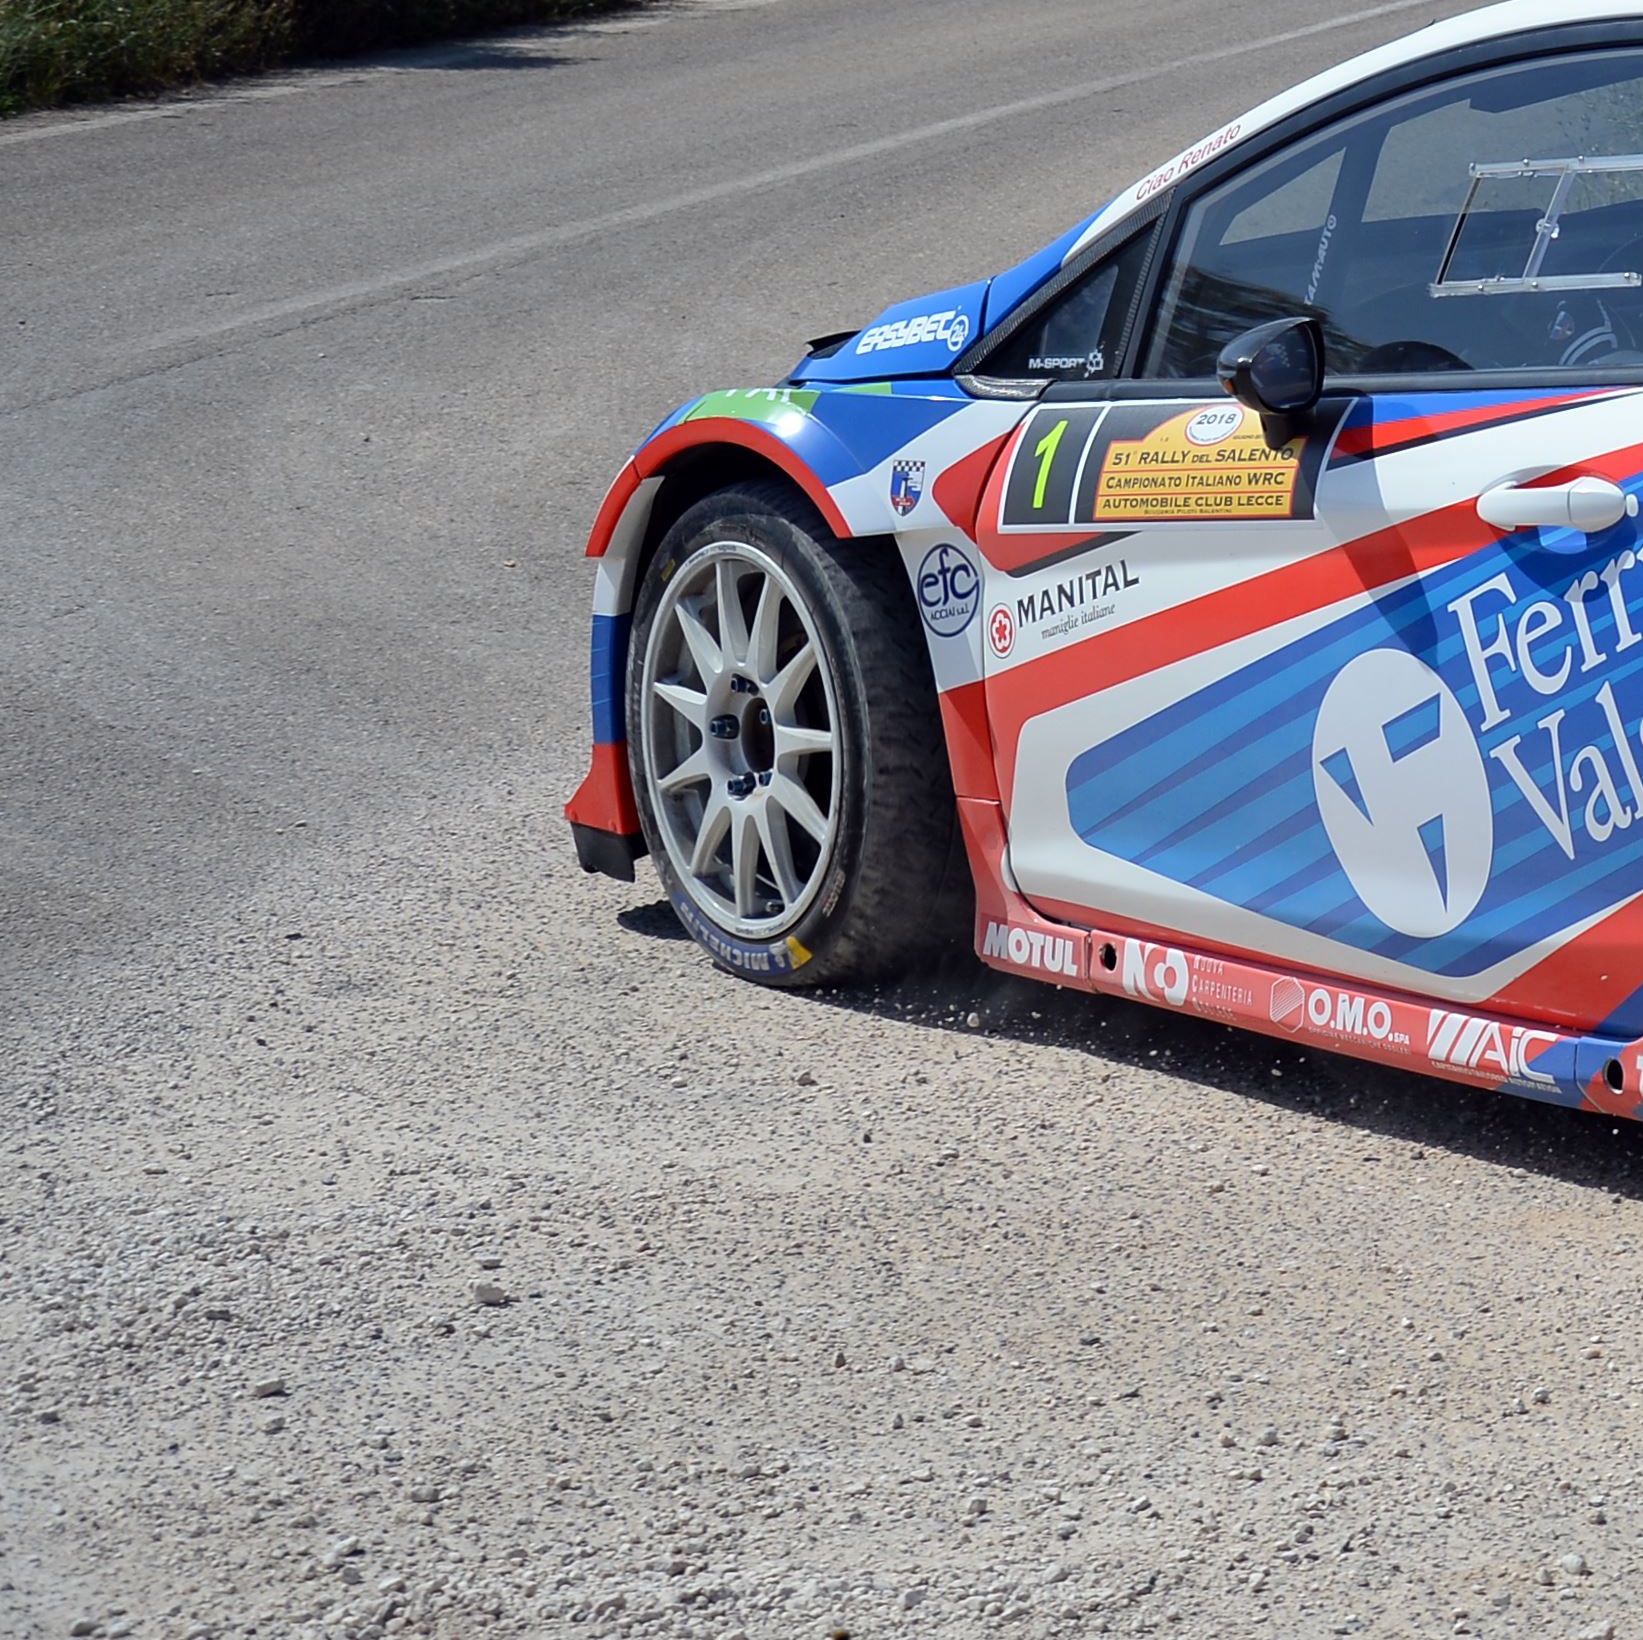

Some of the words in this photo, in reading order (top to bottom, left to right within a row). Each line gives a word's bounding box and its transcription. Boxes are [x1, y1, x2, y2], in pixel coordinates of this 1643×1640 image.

[1136, 167, 1174, 200] Ciao
[1178, 125, 1241, 174] Renato
[856, 310, 955, 354] EASYBET
[1028, 358, 1085, 369] M-SPORT
[1196, 413, 1237, 425] 2018
[1033, 419, 1069, 509] 1
[1138, 451, 1191, 465] RALLY
[1215, 447, 1294, 463] SALENTO
[1106, 476, 1182, 490] CAMPIONATO
[1185, 473, 1242, 488] ITALIANO
[1247, 472, 1286, 487] WRC
[1103, 496, 1190, 509] AUTOMOBILE
[1194, 496, 1233, 508] CLUB
[1237, 495, 1284, 507] LECCE
[1016, 560, 1140, 628] MANITAL
[1041, 613, 1079, 640] maniglie
[1081, 604, 1116, 627] italiane
[983, 921, 1077, 978] MOTUL
[1192, 974, 1253, 1006] CARPENTERIA
